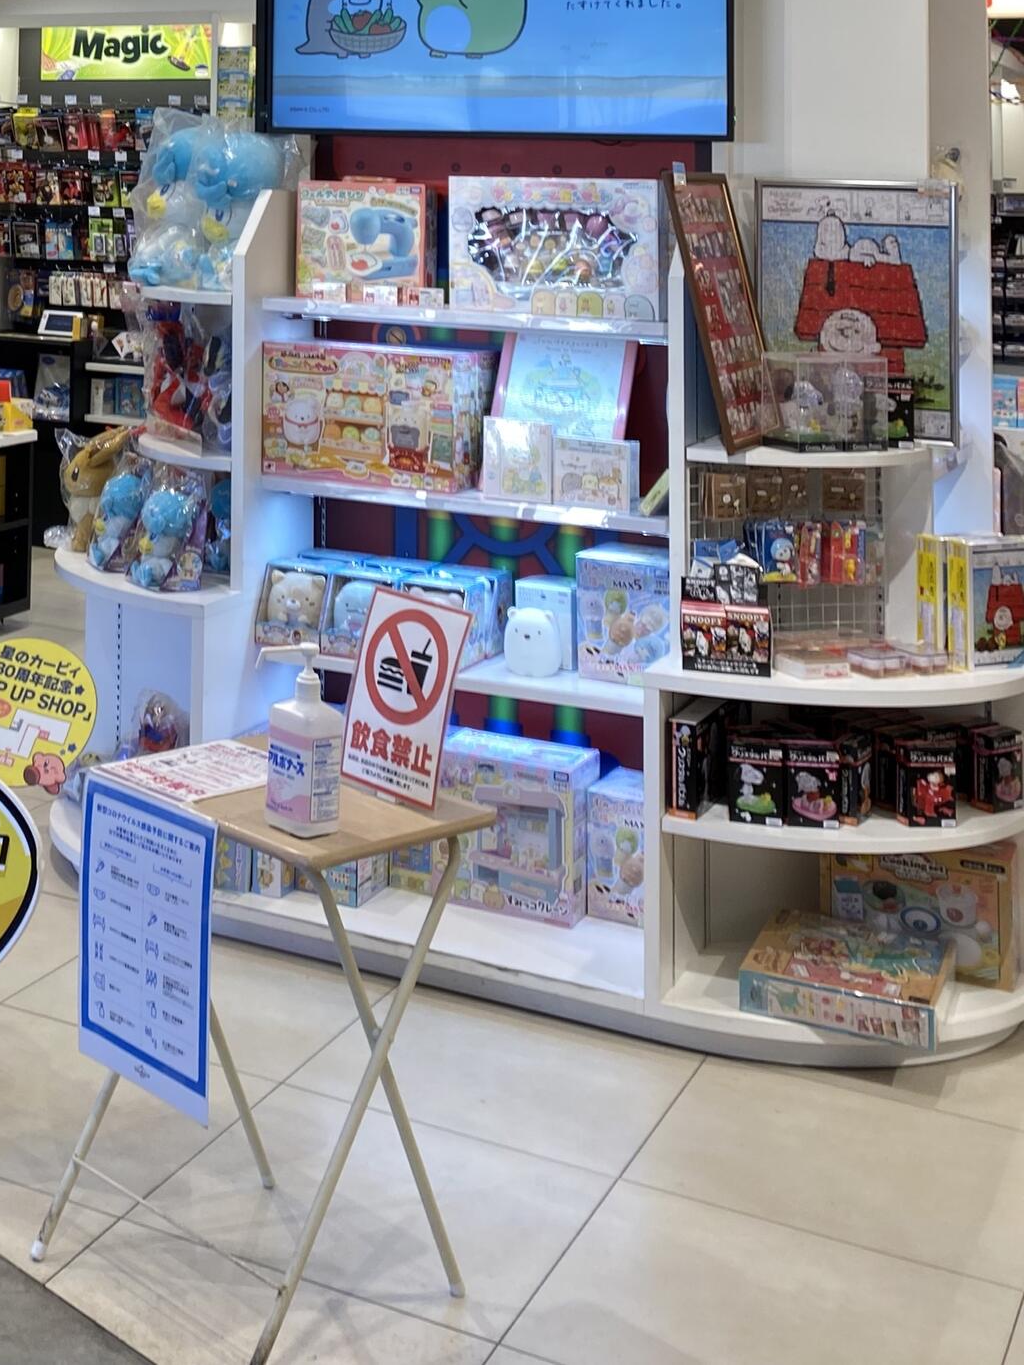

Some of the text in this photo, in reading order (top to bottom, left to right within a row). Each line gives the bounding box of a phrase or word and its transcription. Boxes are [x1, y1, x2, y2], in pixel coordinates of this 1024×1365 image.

[72, 27, 168, 64] Magic
[684, 615, 722, 626] SNOOPY
[726, 612, 765, 622] SNOOPY
[0, 644, 81, 679] 星のカービィ
[9, 685, 36, 704] UP
[350, 719, 433, 778] 飲食禁止
